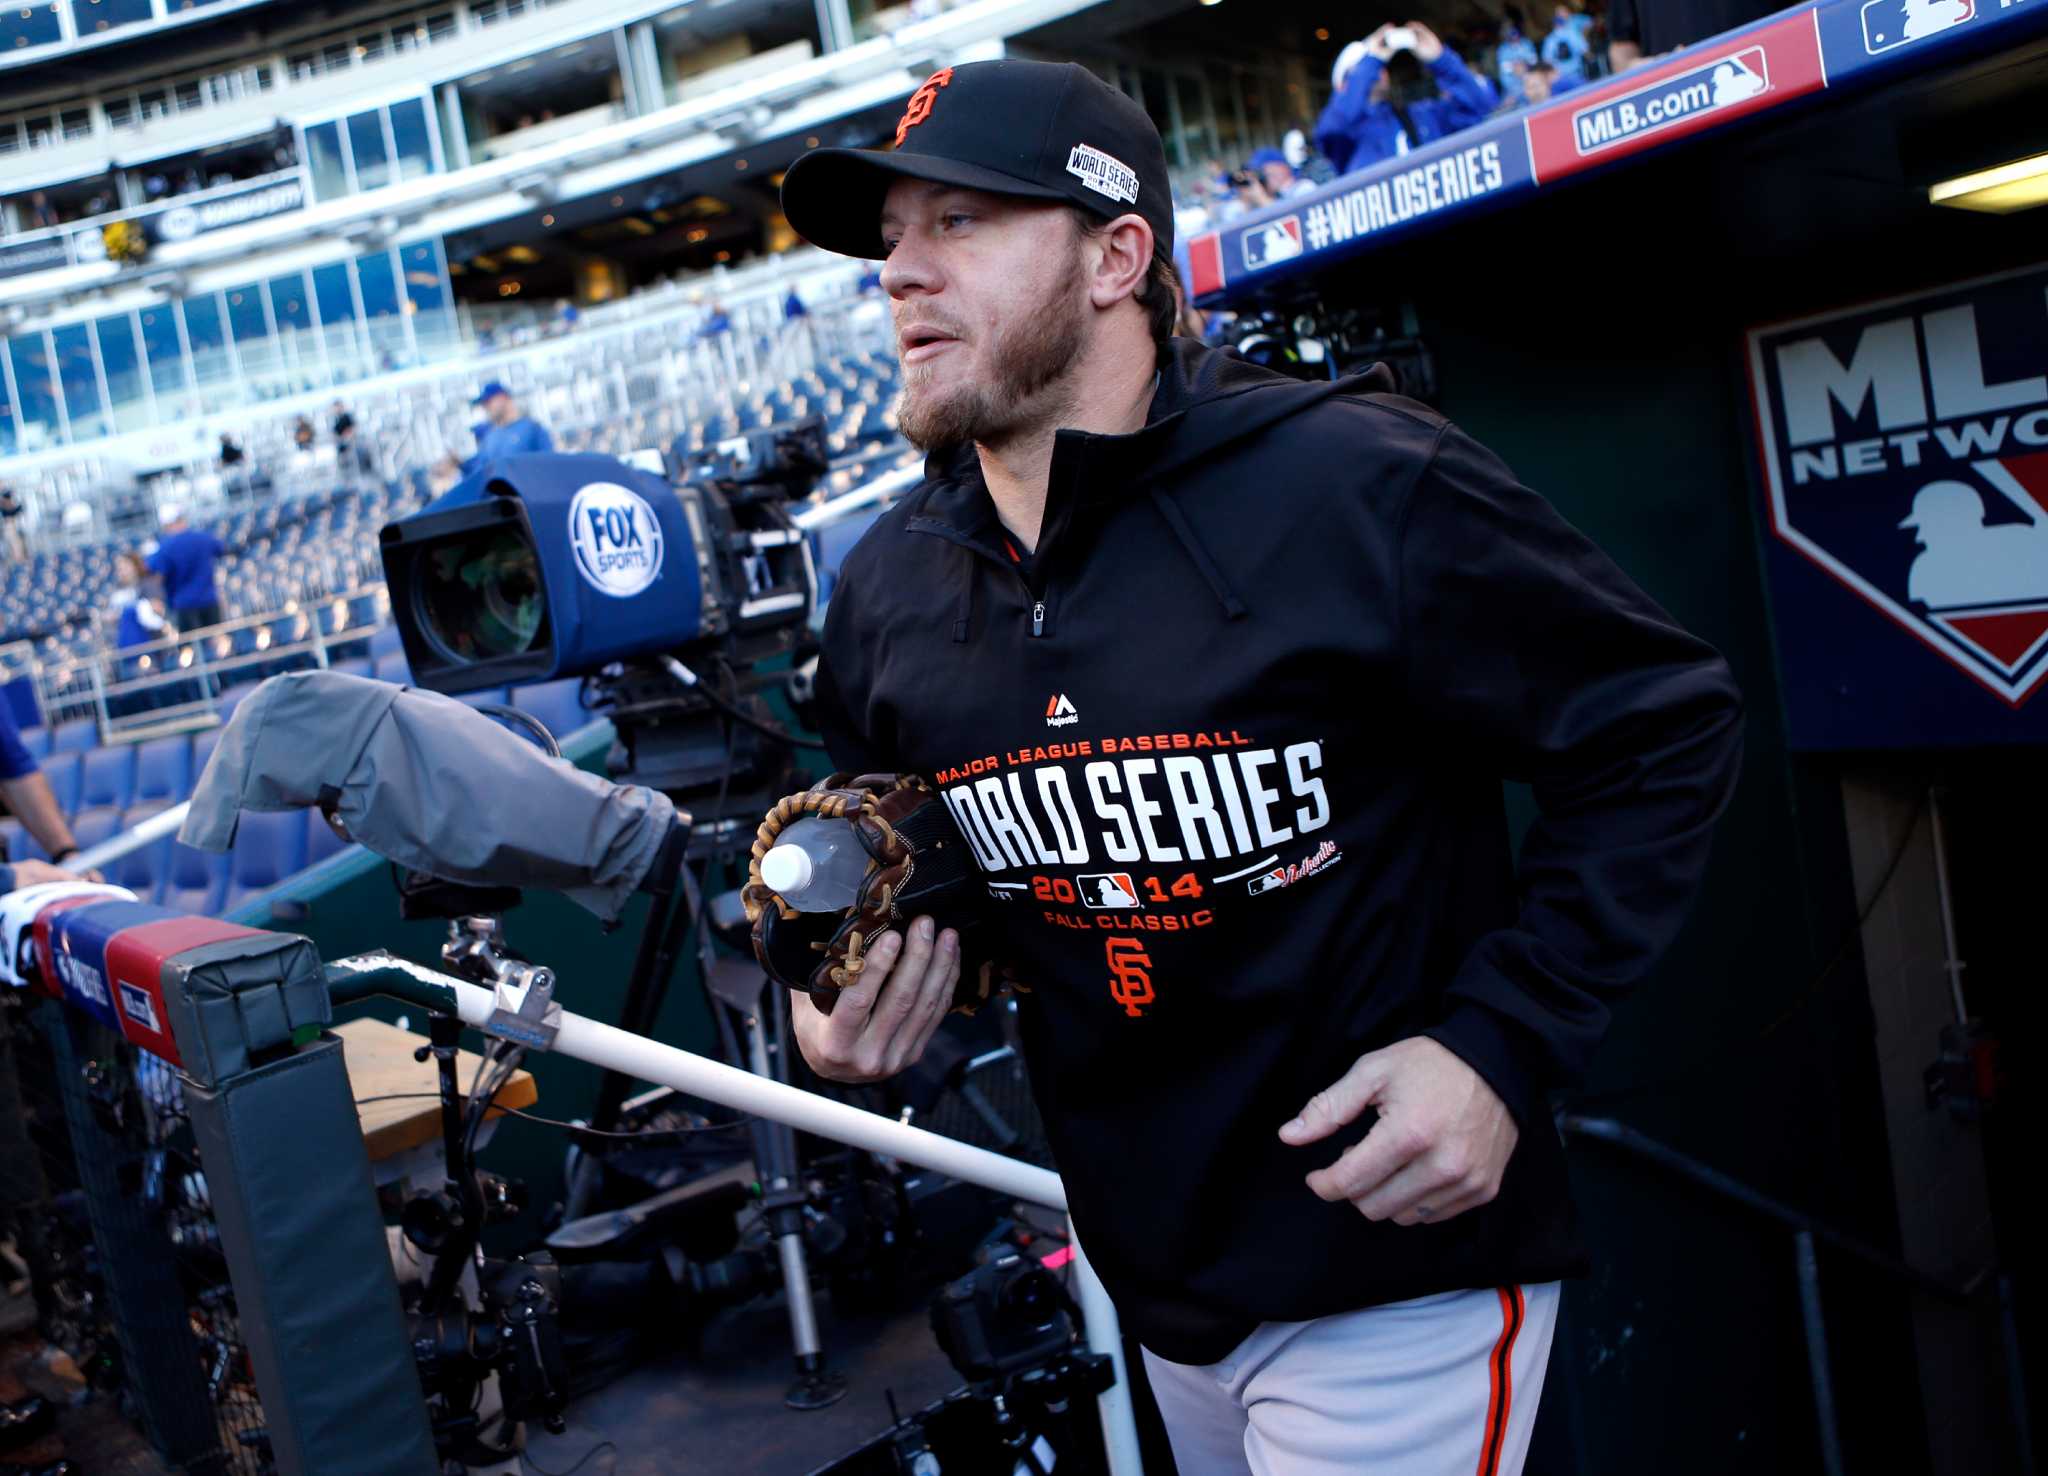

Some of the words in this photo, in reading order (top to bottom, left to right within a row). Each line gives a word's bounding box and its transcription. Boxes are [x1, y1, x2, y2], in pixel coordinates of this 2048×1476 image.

[1580, 83, 1712, 147] MLB.com
[1072, 151, 1106, 178] WORLD
[1108, 165, 1138, 199] SERIES
[1305, 142, 1502, 249] #WORLDSERIES
[1776, 286, 2048, 447] ML
[587, 506, 642, 552] FOX
[598, 551, 649, 573] SPORTS
[1046, 713, 1079, 728] Majestic
[936, 756, 999, 784] MAJOR
[1007, 740, 1092, 766] LEAGUE
[1101, 730, 1249, 753] BASEBALL
[941, 765, 1090, 873] ORLD
[1084, 741, 1331, 863] SERIES
[1032, 875, 1076, 904] 20
[1144, 872, 1204, 902] 14
[1043, 911, 1092, 929] FALL
[1096, 909, 1214, 931] CLASSIC
